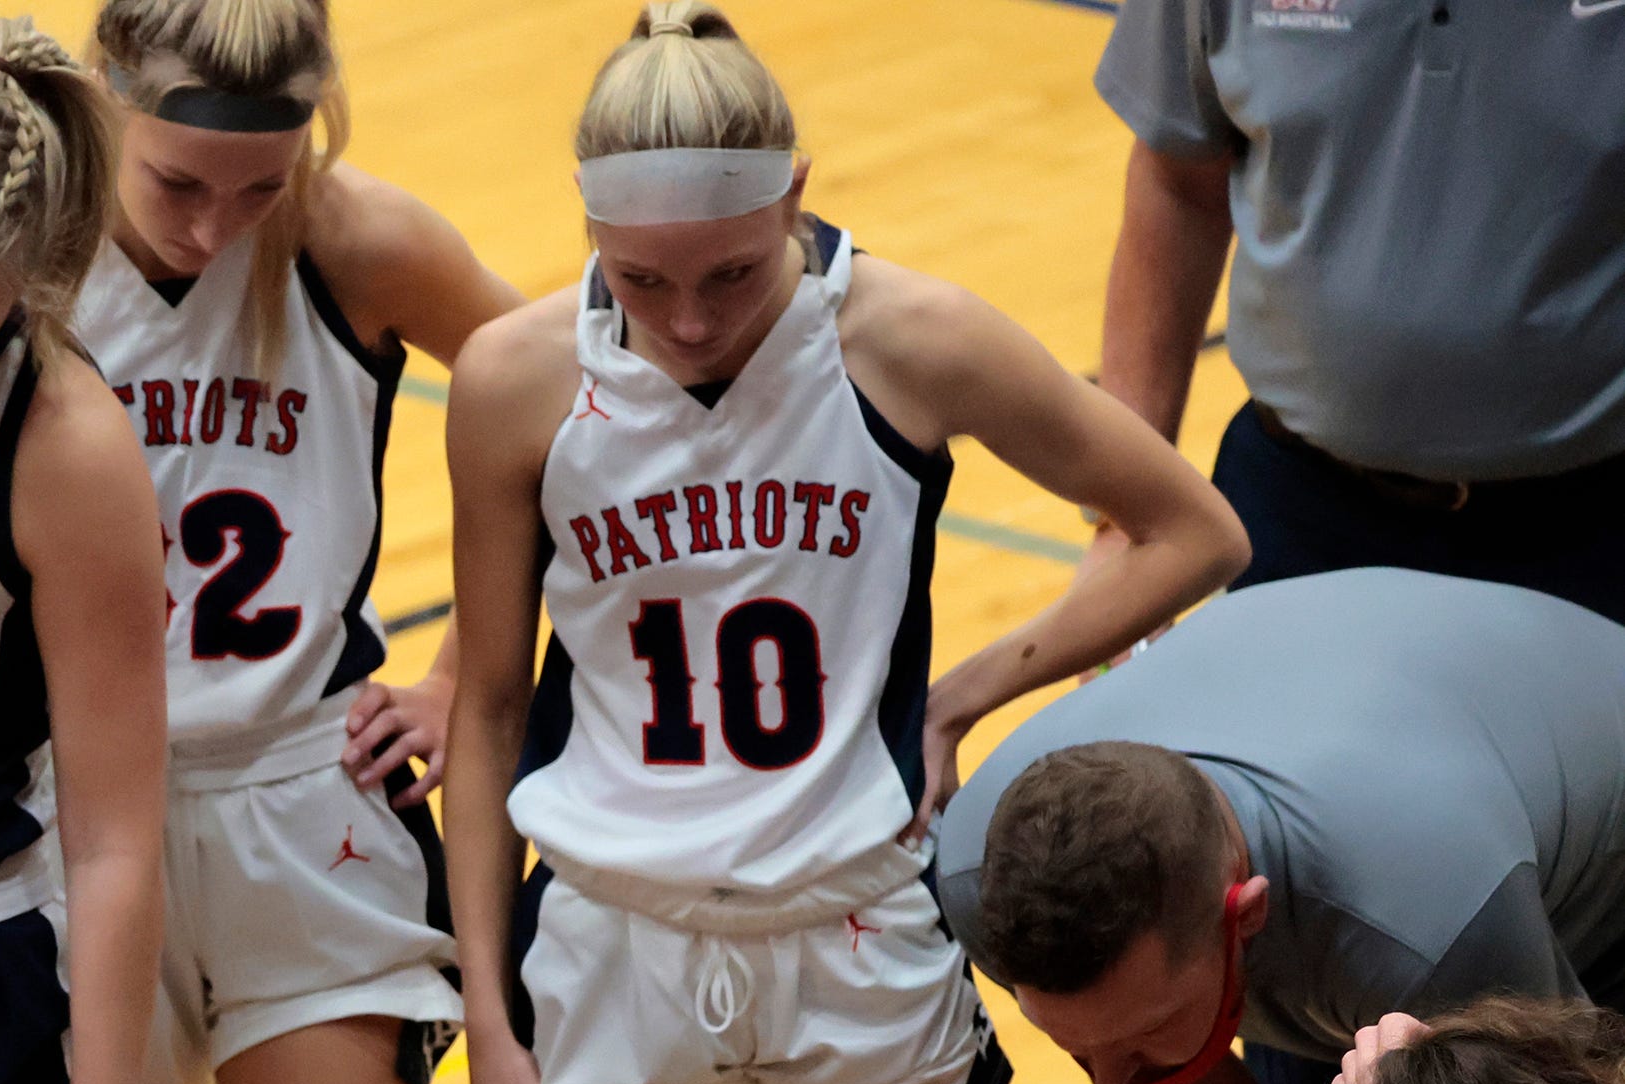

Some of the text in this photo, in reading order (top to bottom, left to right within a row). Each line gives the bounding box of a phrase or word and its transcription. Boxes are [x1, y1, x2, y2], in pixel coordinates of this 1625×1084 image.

[161, 488, 293, 661] 2
[569, 479, 871, 583] PATRIOTS
[628, 596, 828, 771] 10
